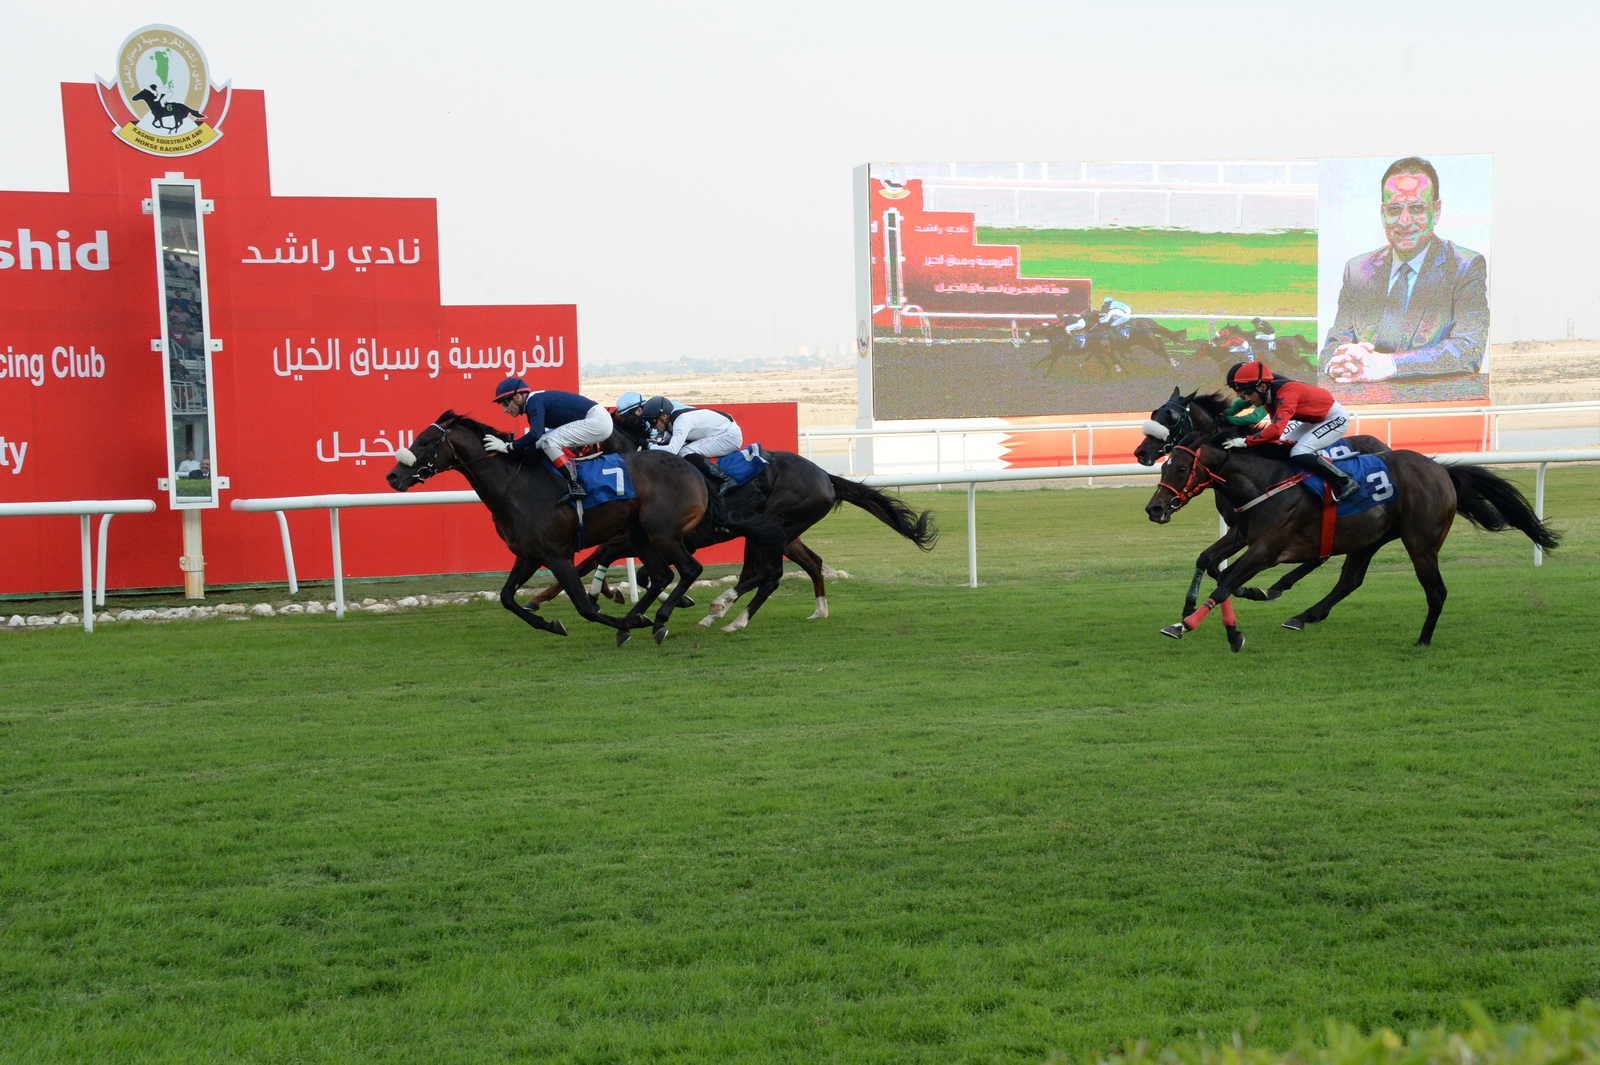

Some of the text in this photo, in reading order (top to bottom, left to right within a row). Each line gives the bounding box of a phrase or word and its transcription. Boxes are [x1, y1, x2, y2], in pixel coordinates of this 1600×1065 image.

[132, 127, 203, 145] RASHID EQUESTRIAN AND
[135, 137, 158, 150] HORSE
[185, 138, 202, 149] CLUB
[242, 233, 420, 272] نادي راشد
[52, 345, 105, 378] Club
[273, 337, 340, 381] الخيل
[350, 337, 419, 381] سباق
[449, 335, 564, 379] للفروسية
[602, 466, 625, 496] 7
[1366, 470, 1394, 502] 3
